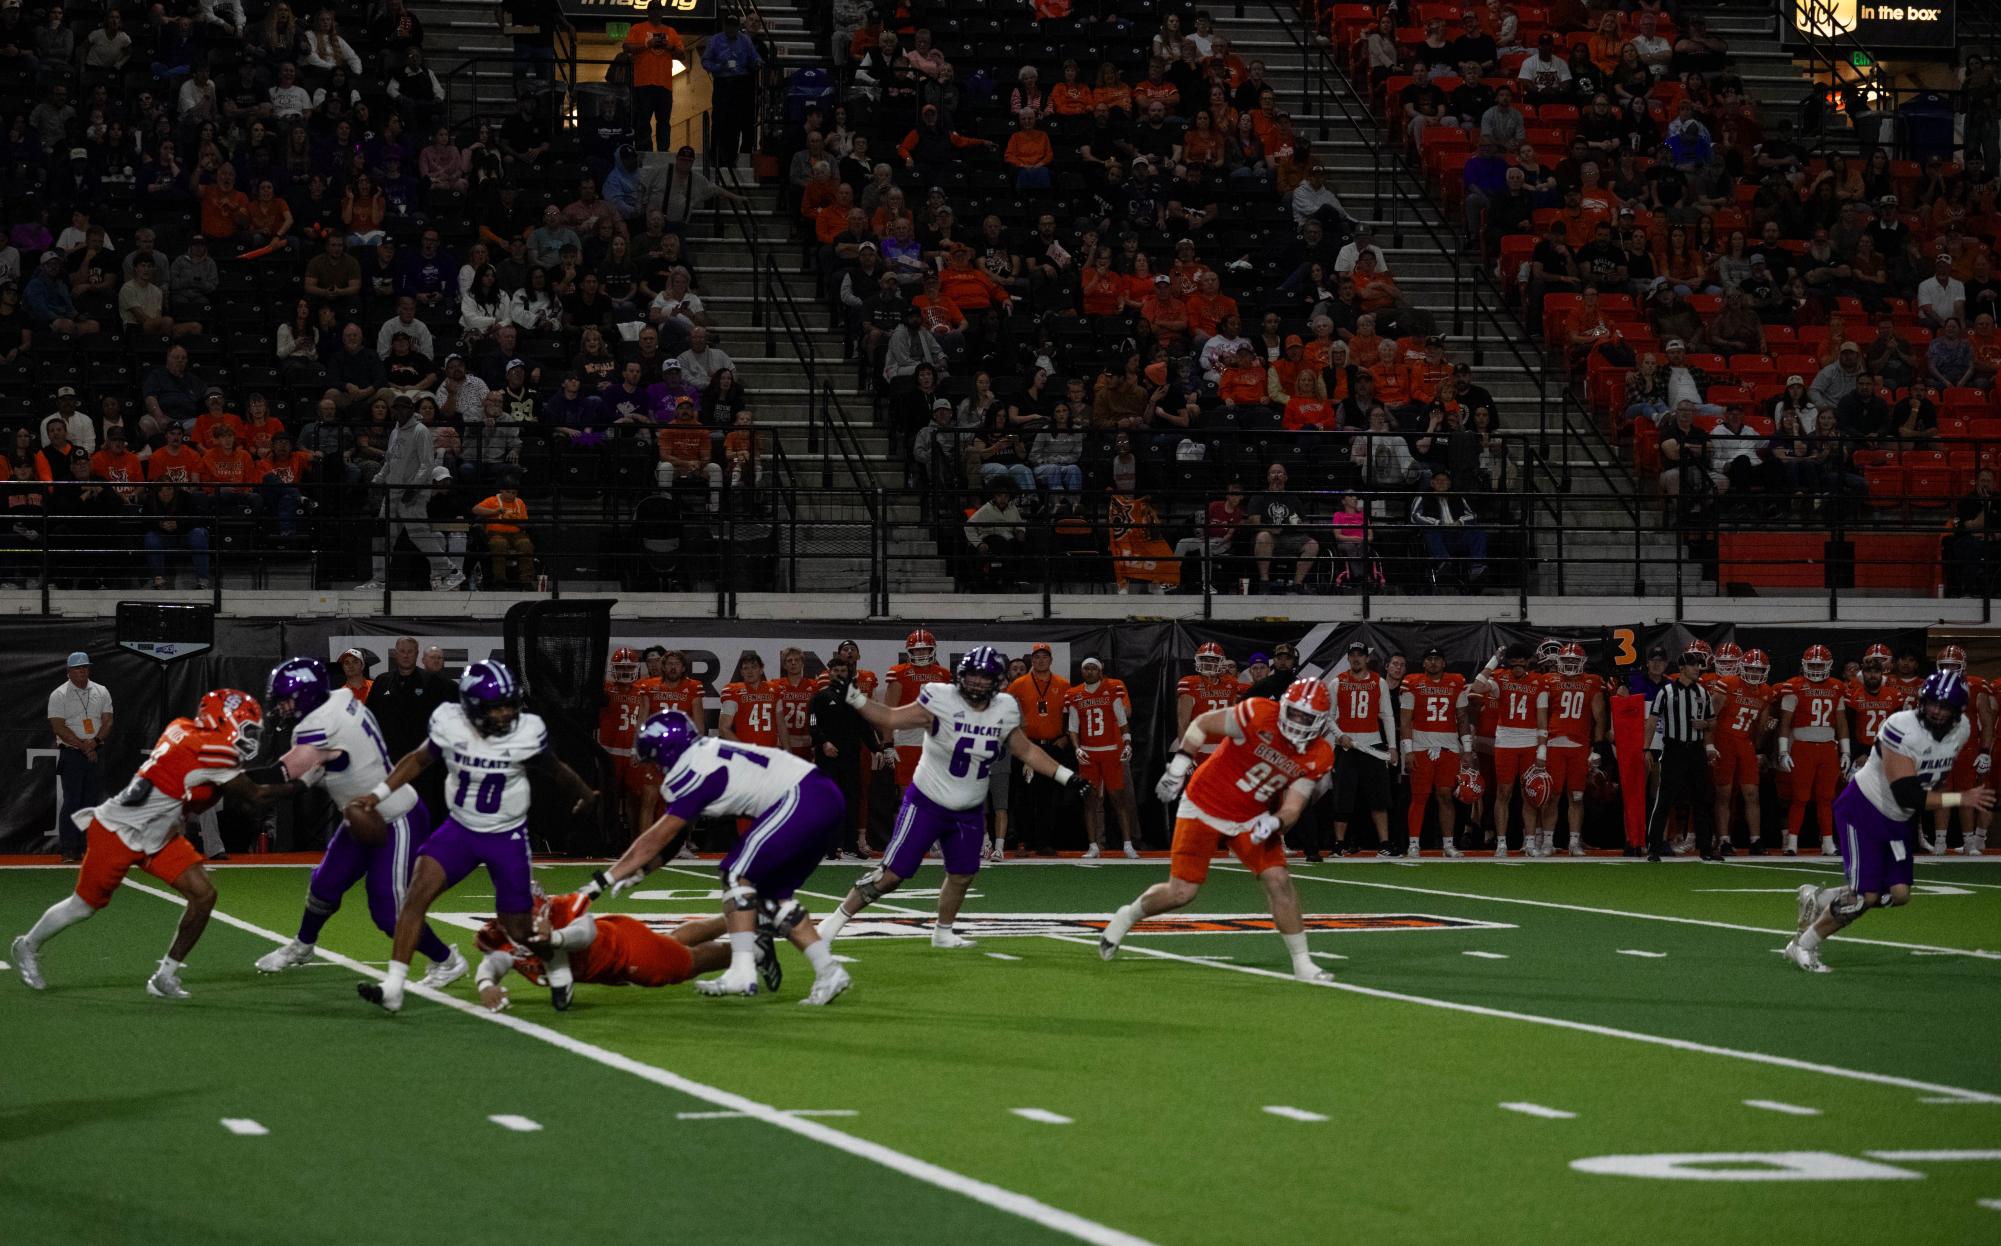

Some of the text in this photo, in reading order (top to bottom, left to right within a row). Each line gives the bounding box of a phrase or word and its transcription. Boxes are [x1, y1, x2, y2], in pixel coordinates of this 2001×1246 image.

[1861, 5, 1875, 20] in
[1878, 6, 1904, 20] the
[1613, 629, 1637, 665] 3
[749, 703, 772, 732] 45
[784, 703, 807, 729] 26
[1350, 691, 1369, 719] 18
[1426, 697, 1449, 722] 52
[1509, 693, 1528, 721] 14
[1559, 691, 1585, 719] 90
[1731, 706, 1759, 732] 57
[1810, 698, 1833, 727] 92
[954, 721, 1002, 738] WILDCATS
[1086, 708, 1105, 737] 13
[454, 752, 511, 769] WILDCATS
[949, 736, 1004, 780] 62
[454, 769, 507, 814] 10
